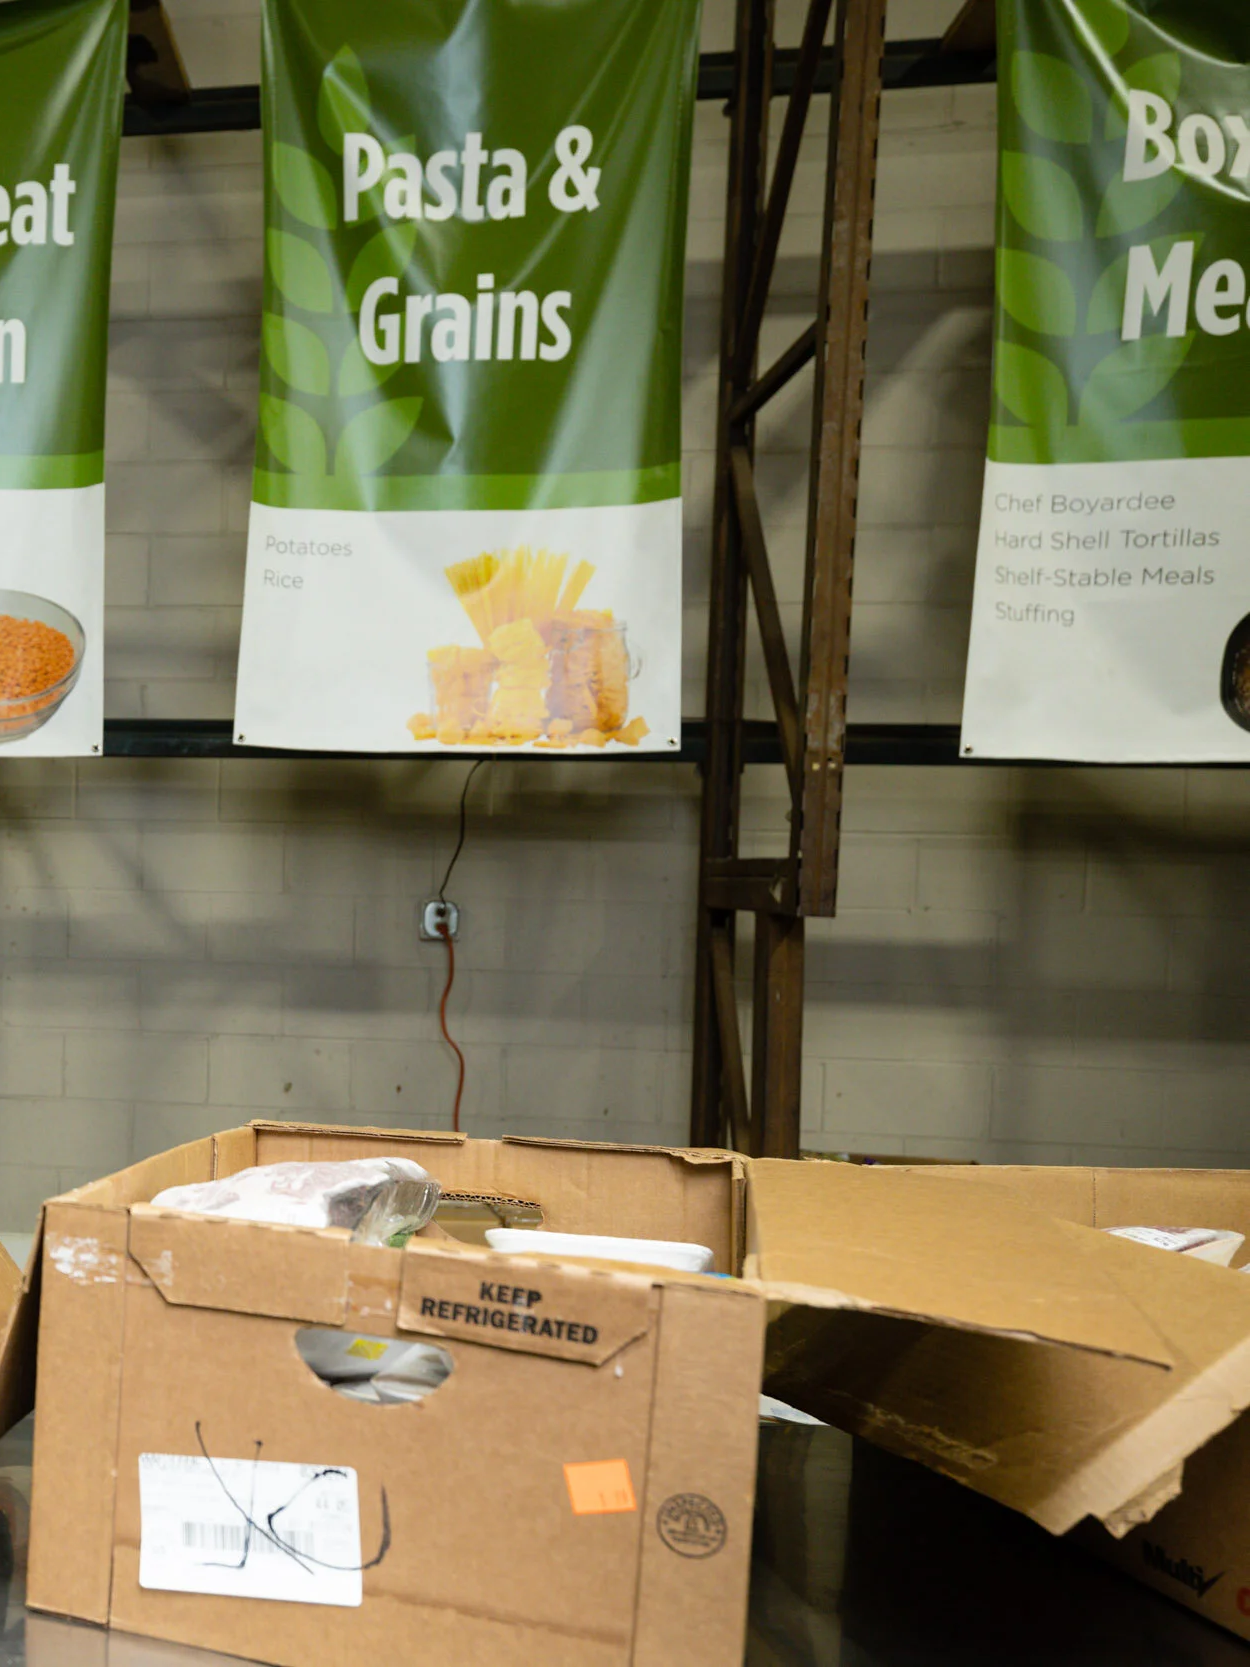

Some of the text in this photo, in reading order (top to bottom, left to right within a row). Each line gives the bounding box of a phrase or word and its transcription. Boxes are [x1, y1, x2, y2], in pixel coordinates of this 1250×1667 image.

[343, 125, 601, 222] Pasta &
[1121, 240, 1250, 341] Me
[358, 273, 572, 366] Grains
[994, 492, 1176, 516] Chef Boyardee
[265, 535, 353, 557] Potatoes
[995, 529, 1220, 550] Hard Shell Tortillas
[263, 569, 304, 589] Rice
[995, 565, 1215, 588] Shelf-Stable Meals
[995, 602, 1075, 627] Stuffing
[479, 1281, 542, 1310] KEEP
[420, 1295, 599, 1347] REFRIGERATED
